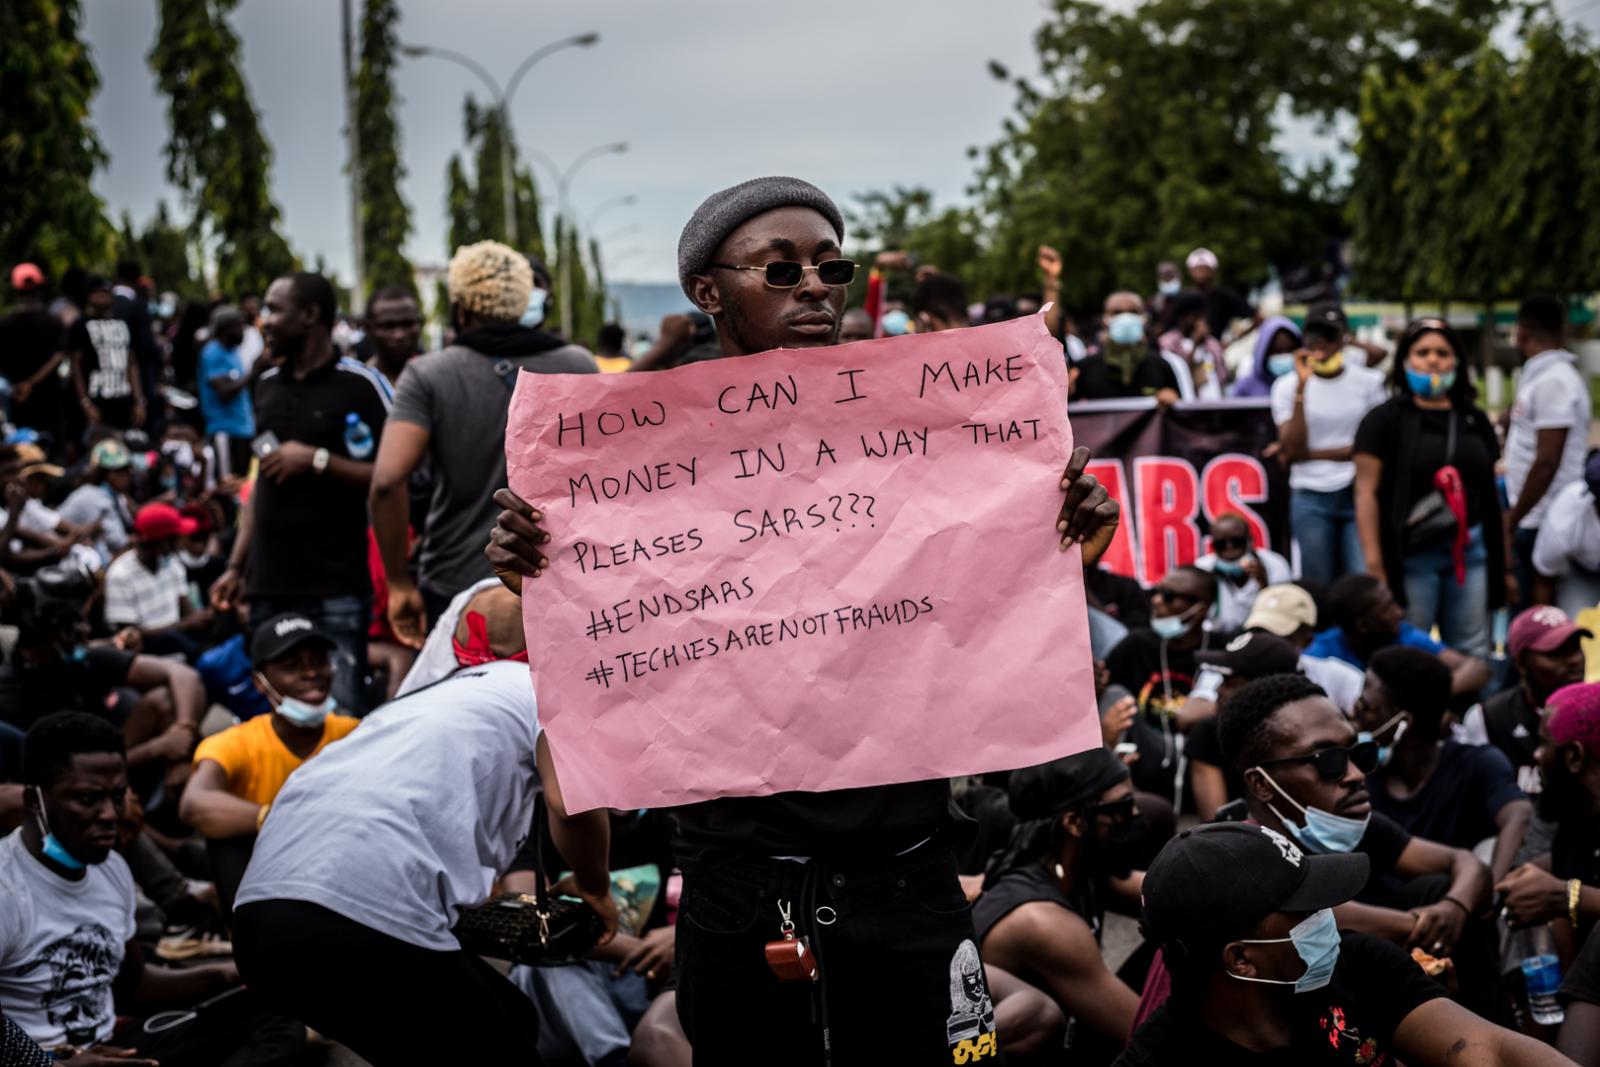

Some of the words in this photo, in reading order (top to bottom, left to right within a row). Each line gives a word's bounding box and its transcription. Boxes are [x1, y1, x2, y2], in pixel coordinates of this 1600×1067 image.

[557, 400, 666, 447] HOW
[717, 374, 798, 415] CAN
[834, 369, 868, 404] I
[919, 354, 1024, 399] MAKE
[568, 456, 697, 509] MONEY
[729, 442, 785, 479] IN
[815, 439, 837, 467] A
[860, 426, 929, 458] WAY
[962, 418, 1041, 445] THAT
[572, 528, 703, 574] PLEASES
[733, 492, 876, 543] SARS???
[584, 595, 935, 689] #TECHIESARENOTFRAUDS
[585, 575, 755, 642] #ENDSARS
